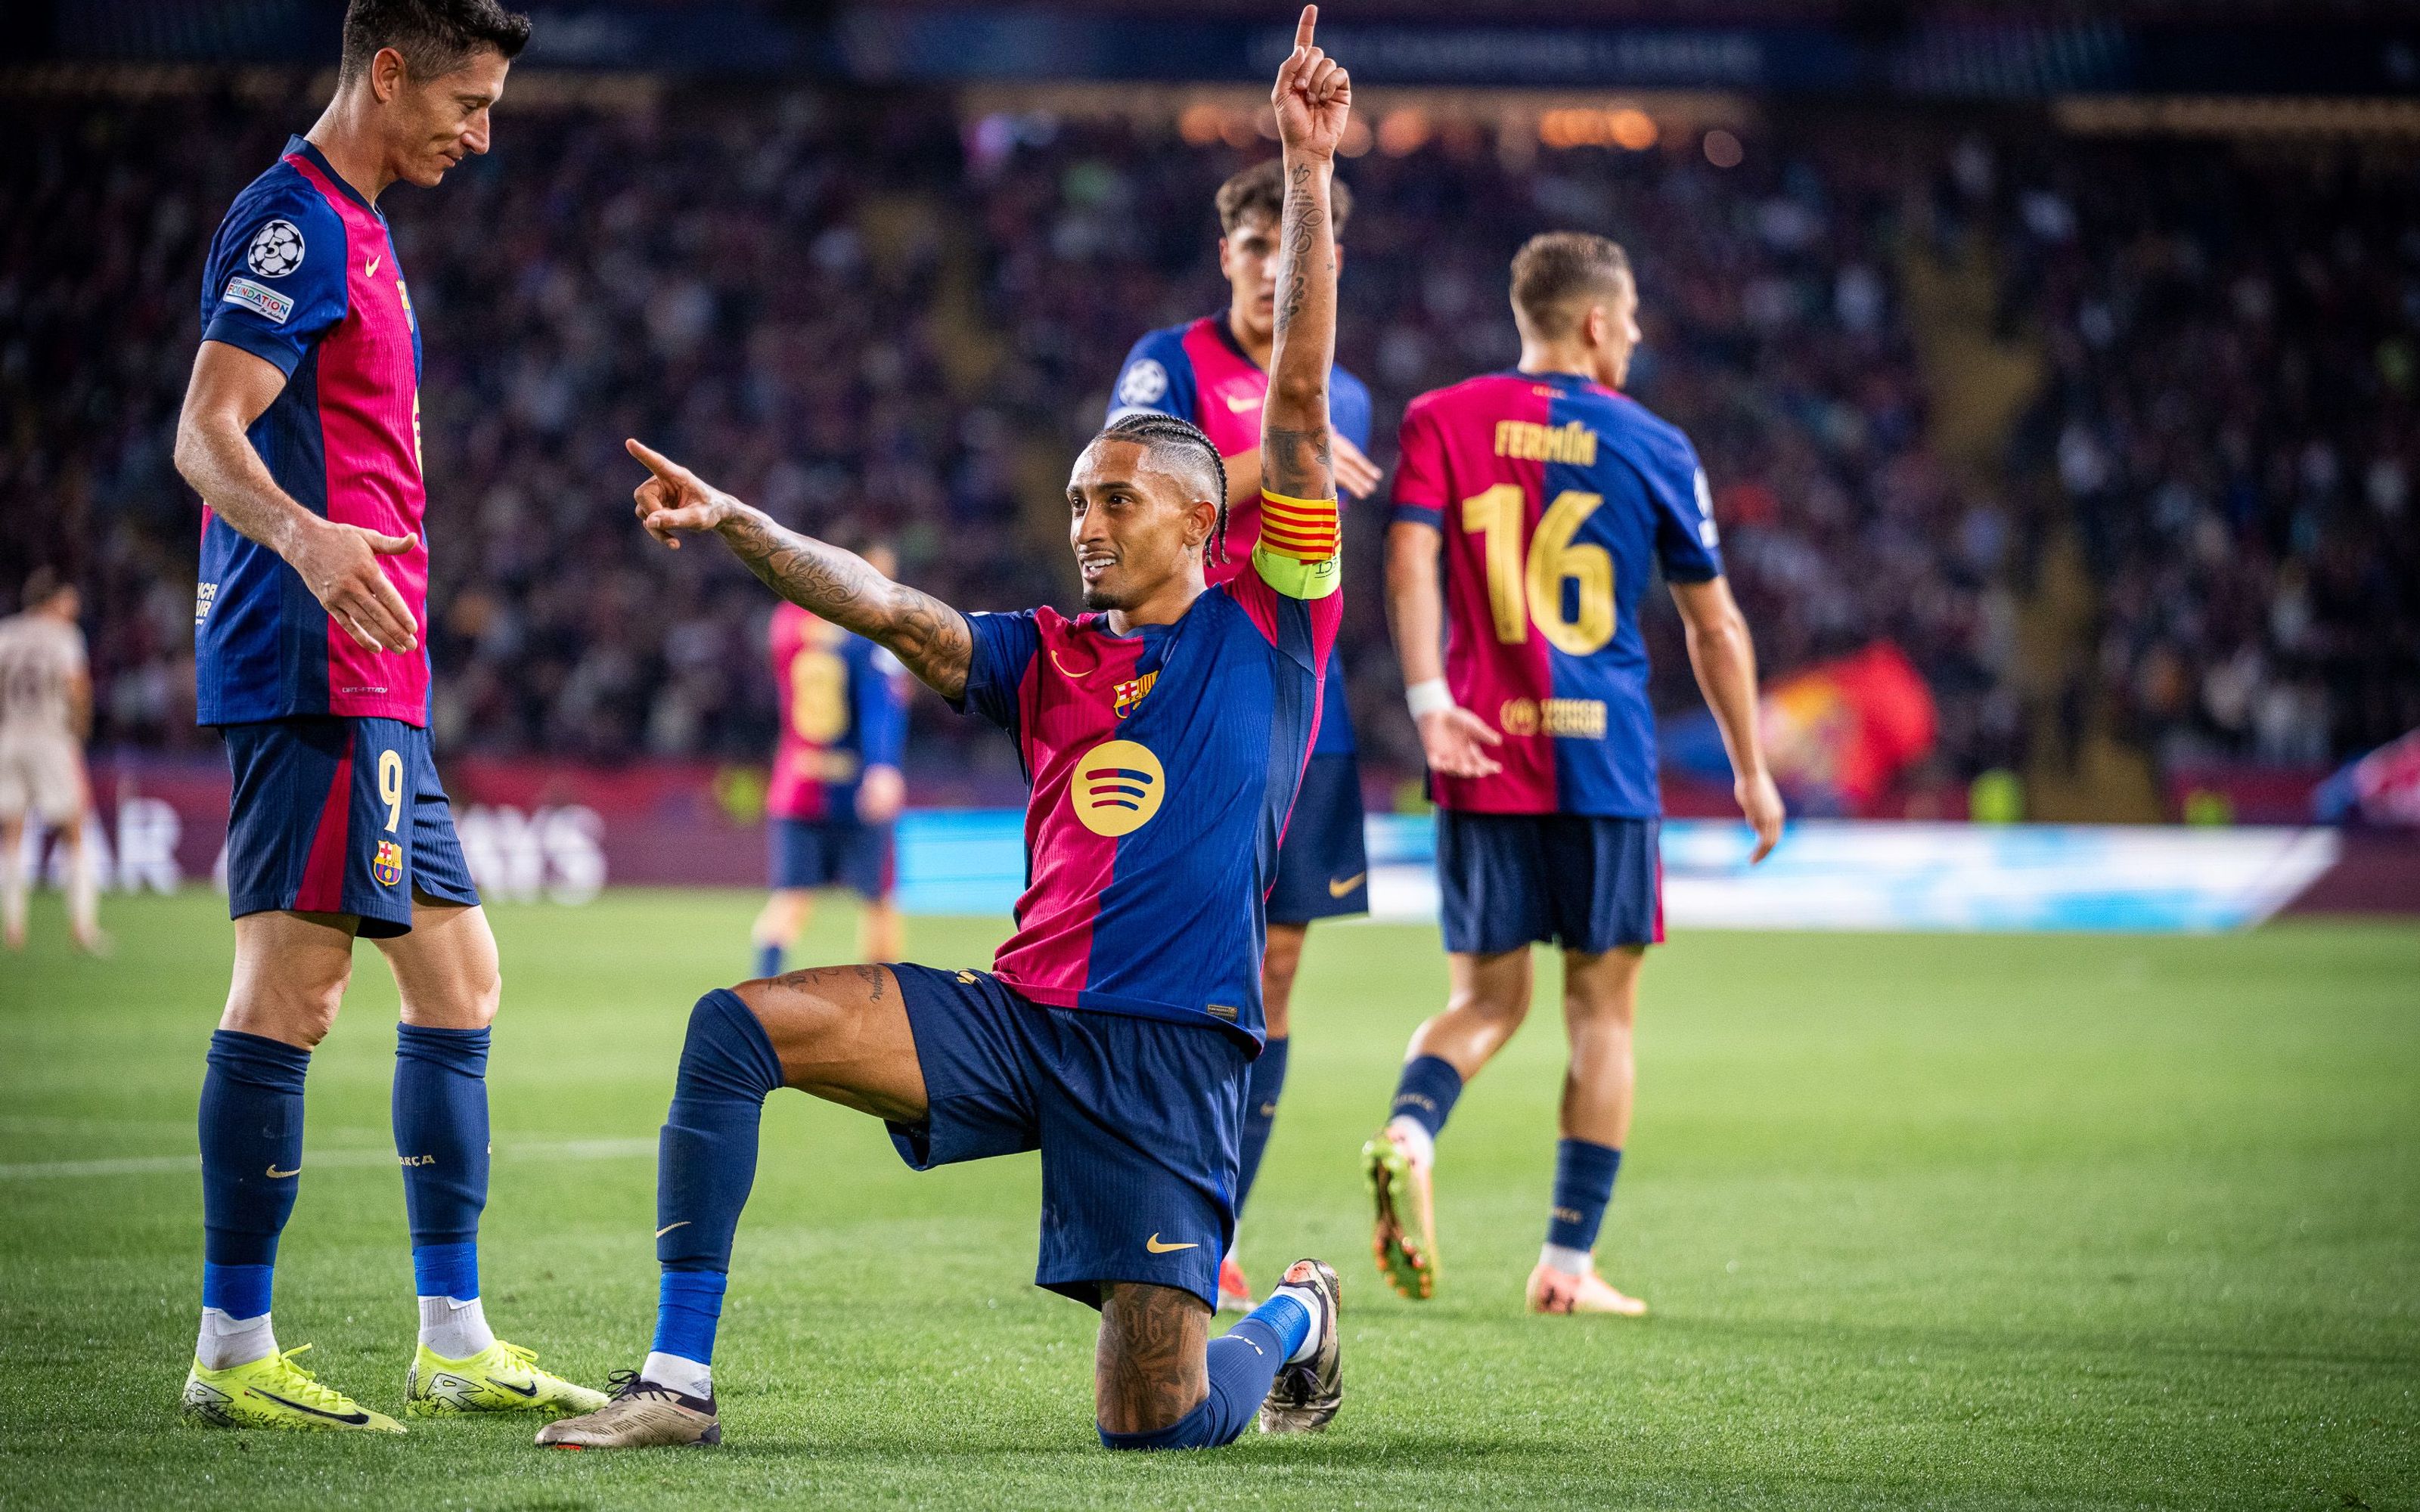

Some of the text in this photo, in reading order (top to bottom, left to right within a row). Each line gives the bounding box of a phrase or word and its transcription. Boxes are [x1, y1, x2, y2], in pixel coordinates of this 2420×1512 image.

[264, 236, 284, 259] 5
[228, 284, 289, 315] FOUNDATION
[1494, 420, 1598, 467] FERMÍN
[1461, 482, 1617, 657] 16
[379, 749, 403, 833] 9
[383, 859, 396, 867] FCB
[399, 1154, 436, 1167] ARÇA
